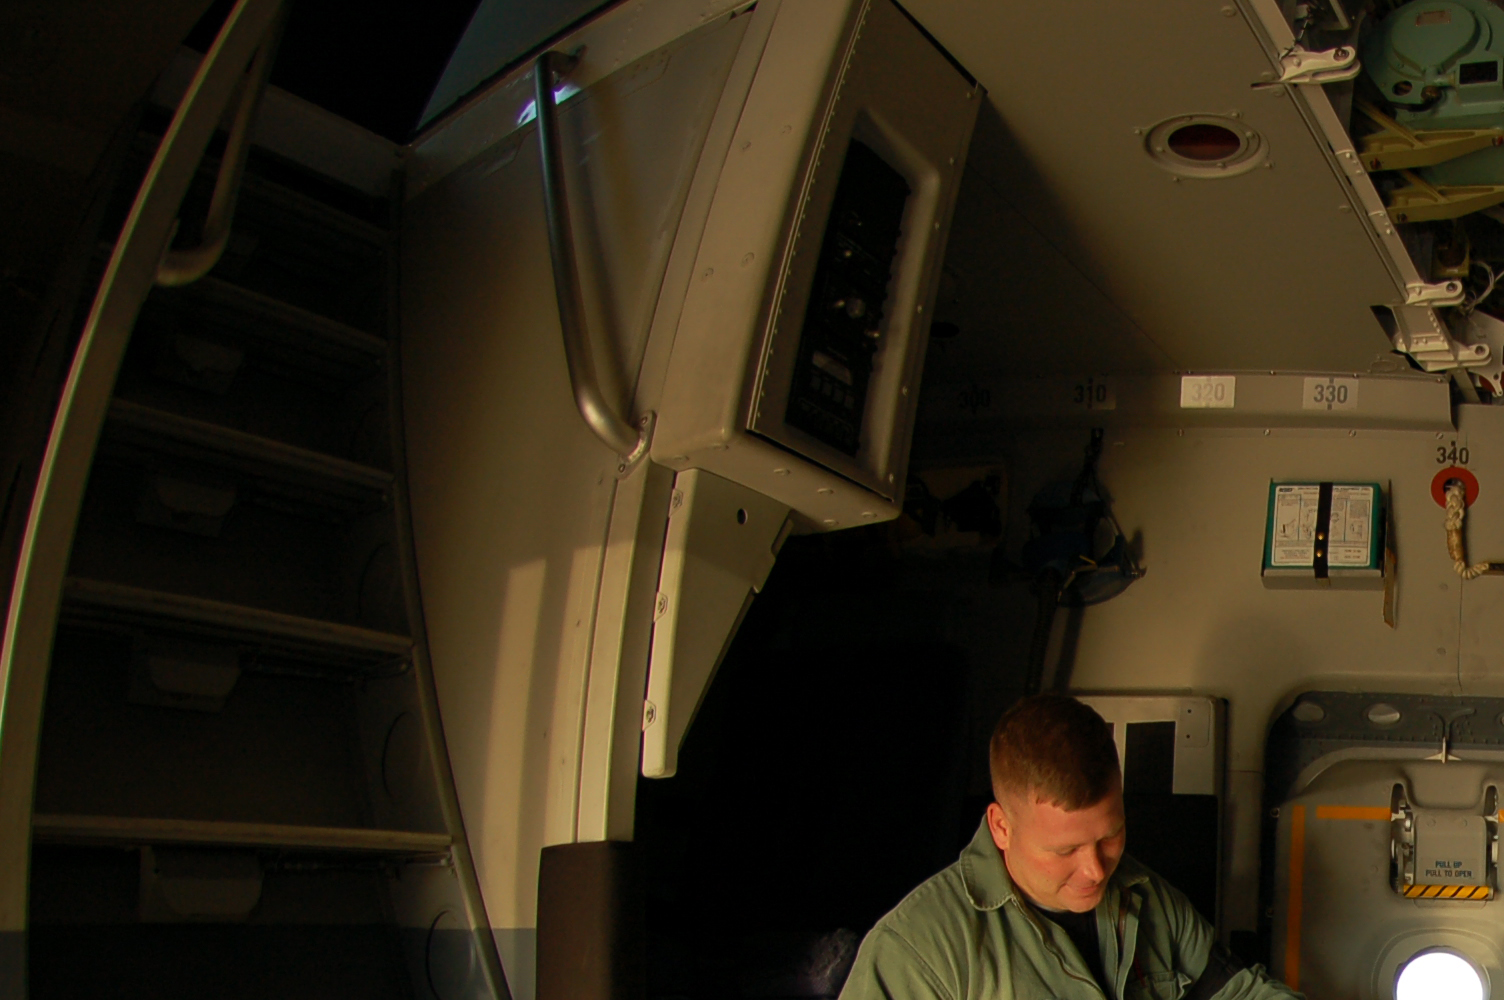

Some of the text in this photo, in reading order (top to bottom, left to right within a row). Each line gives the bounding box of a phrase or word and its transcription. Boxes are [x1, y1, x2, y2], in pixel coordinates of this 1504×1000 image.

[1073, 384, 1107, 404] 310
[1191, 383, 1225, 402] 320
[1314, 384, 1349, 403] 330
[1436, 447, 1469, 464] 340
